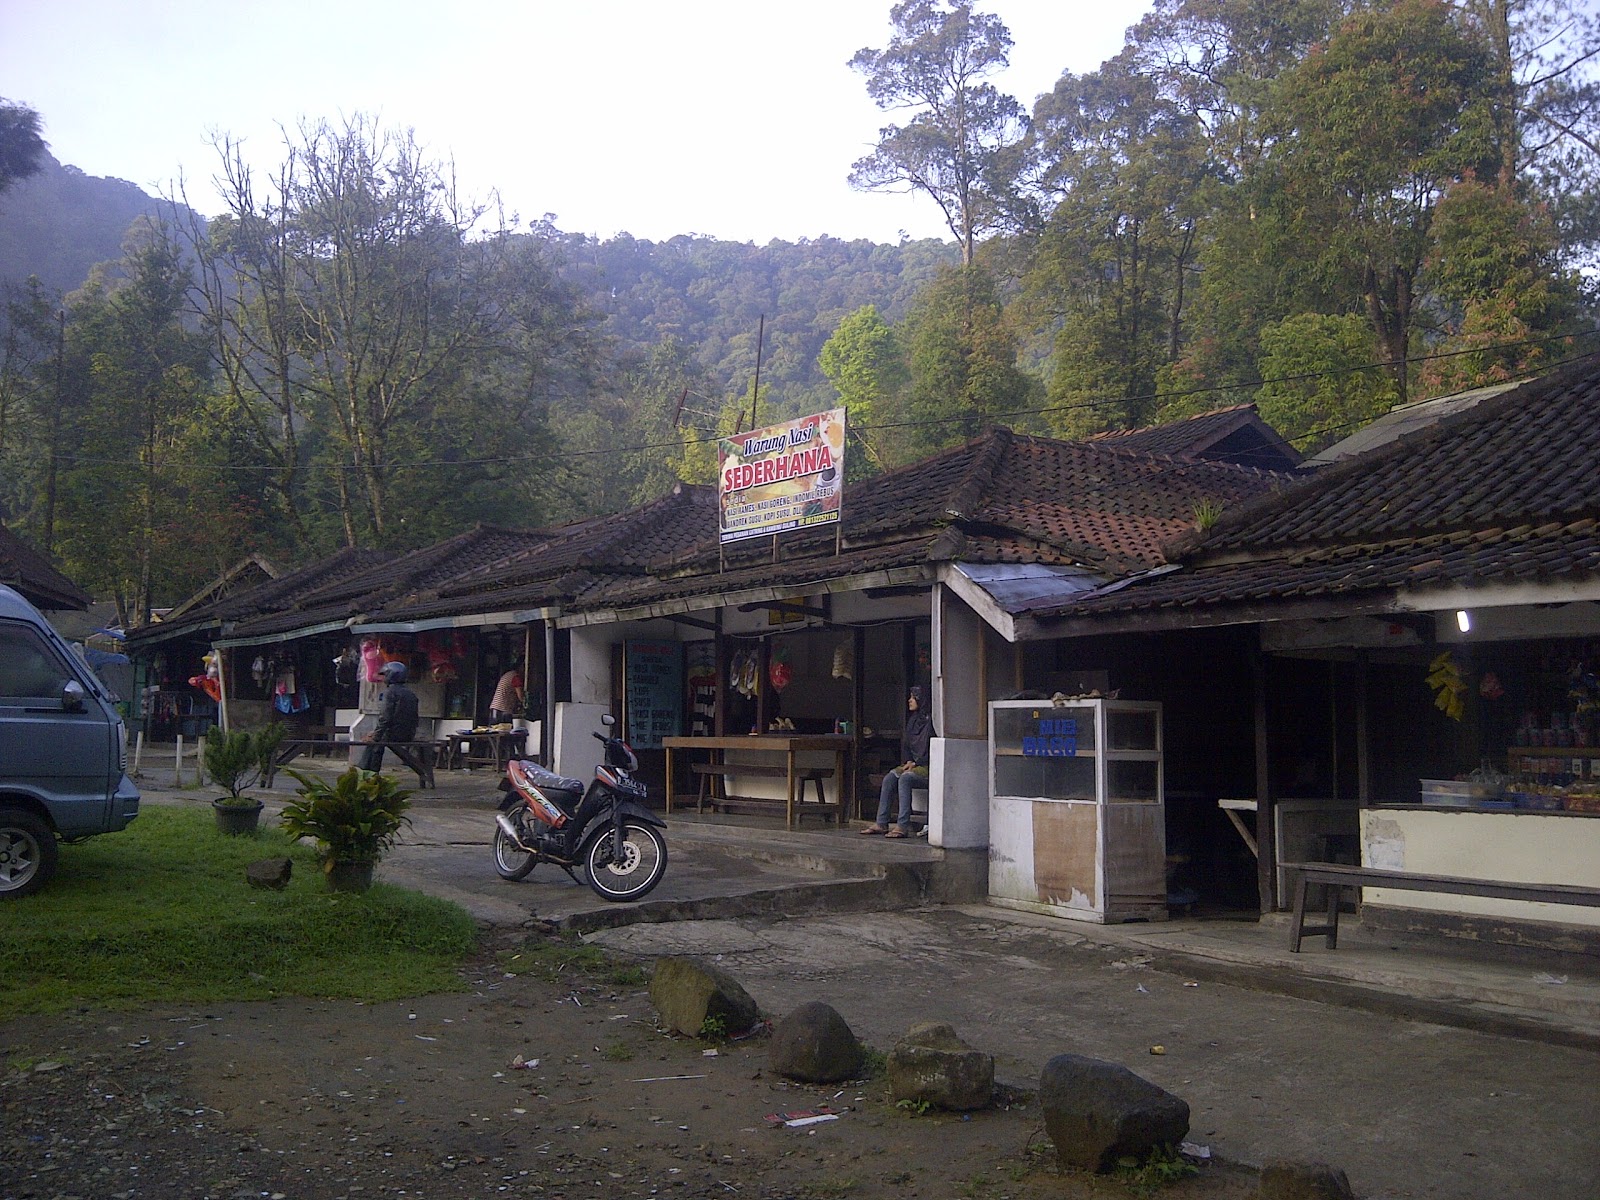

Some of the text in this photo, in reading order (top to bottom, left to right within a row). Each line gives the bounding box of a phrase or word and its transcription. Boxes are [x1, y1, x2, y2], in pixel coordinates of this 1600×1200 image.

[744, 423, 813, 457] Warung Nasi
[724, 445, 832, 493] SEDERHANA
[758, 501, 769, 511] NASI
[816, 486, 834, 498] REBUS
